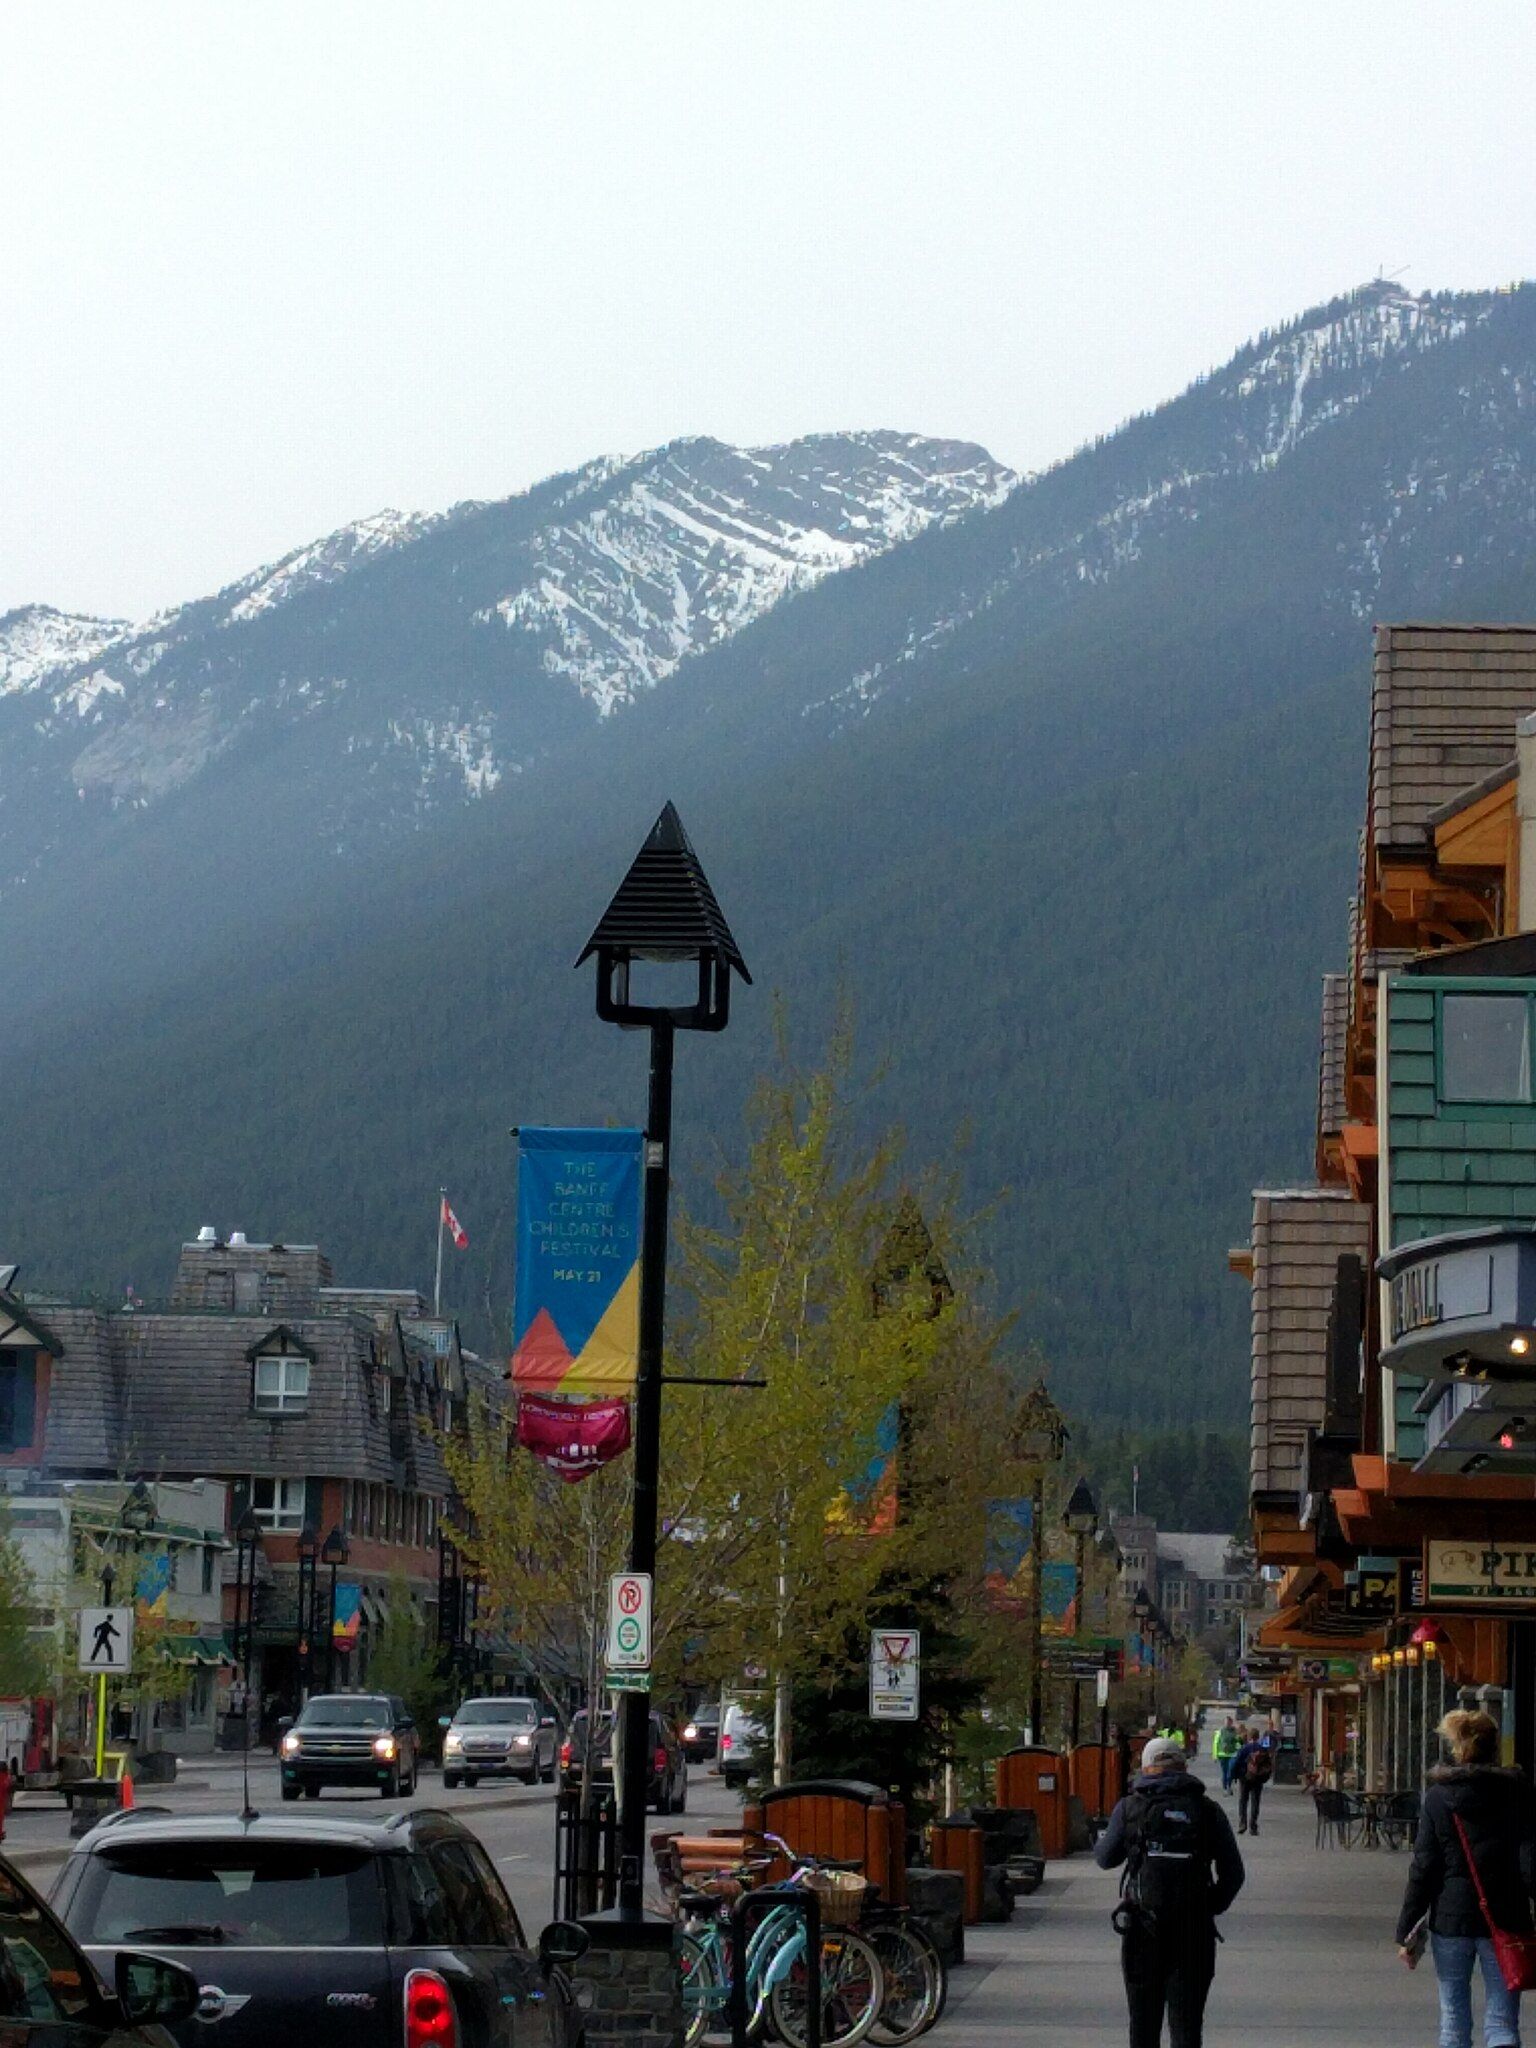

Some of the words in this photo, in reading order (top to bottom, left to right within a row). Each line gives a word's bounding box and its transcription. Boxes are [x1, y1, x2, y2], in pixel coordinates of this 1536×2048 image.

[564, 1162, 596, 1178] THE
[554, 1181, 609, 1197] BANFF
[548, 1202, 615, 1218] CENTRE
[540, 1240, 621, 1259] FESTIVAL
[553, 1268, 583, 1282] MAY
